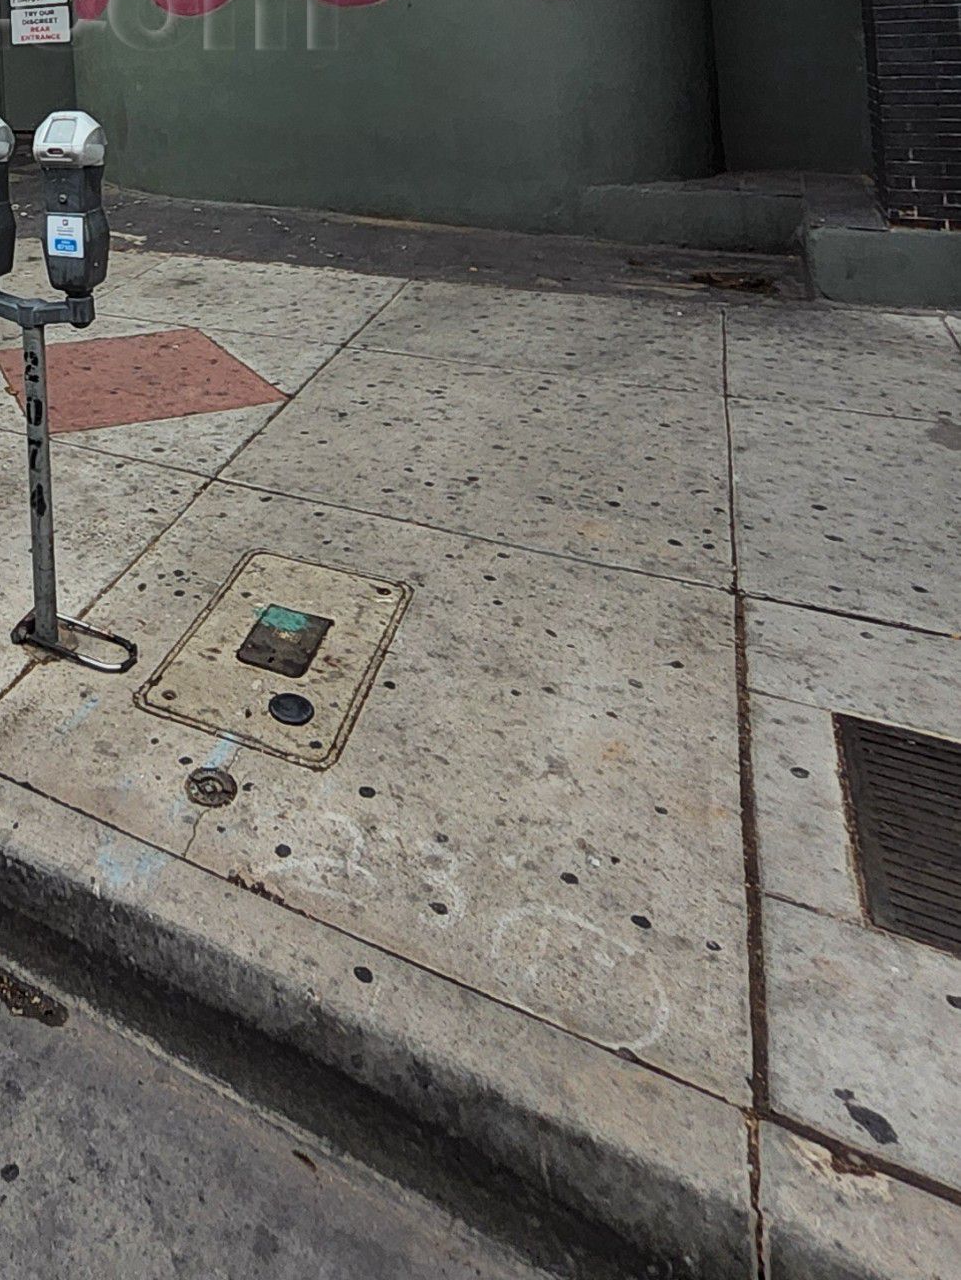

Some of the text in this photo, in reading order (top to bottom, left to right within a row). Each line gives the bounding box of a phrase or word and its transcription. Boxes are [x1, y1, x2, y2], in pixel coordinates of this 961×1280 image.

[24, 10, 37, 18] TRY
[22, 17, 59, 25] DISCREET
[29, 25, 51, 33] REAR
[20, 33, 62, 41] ENTRANCE
